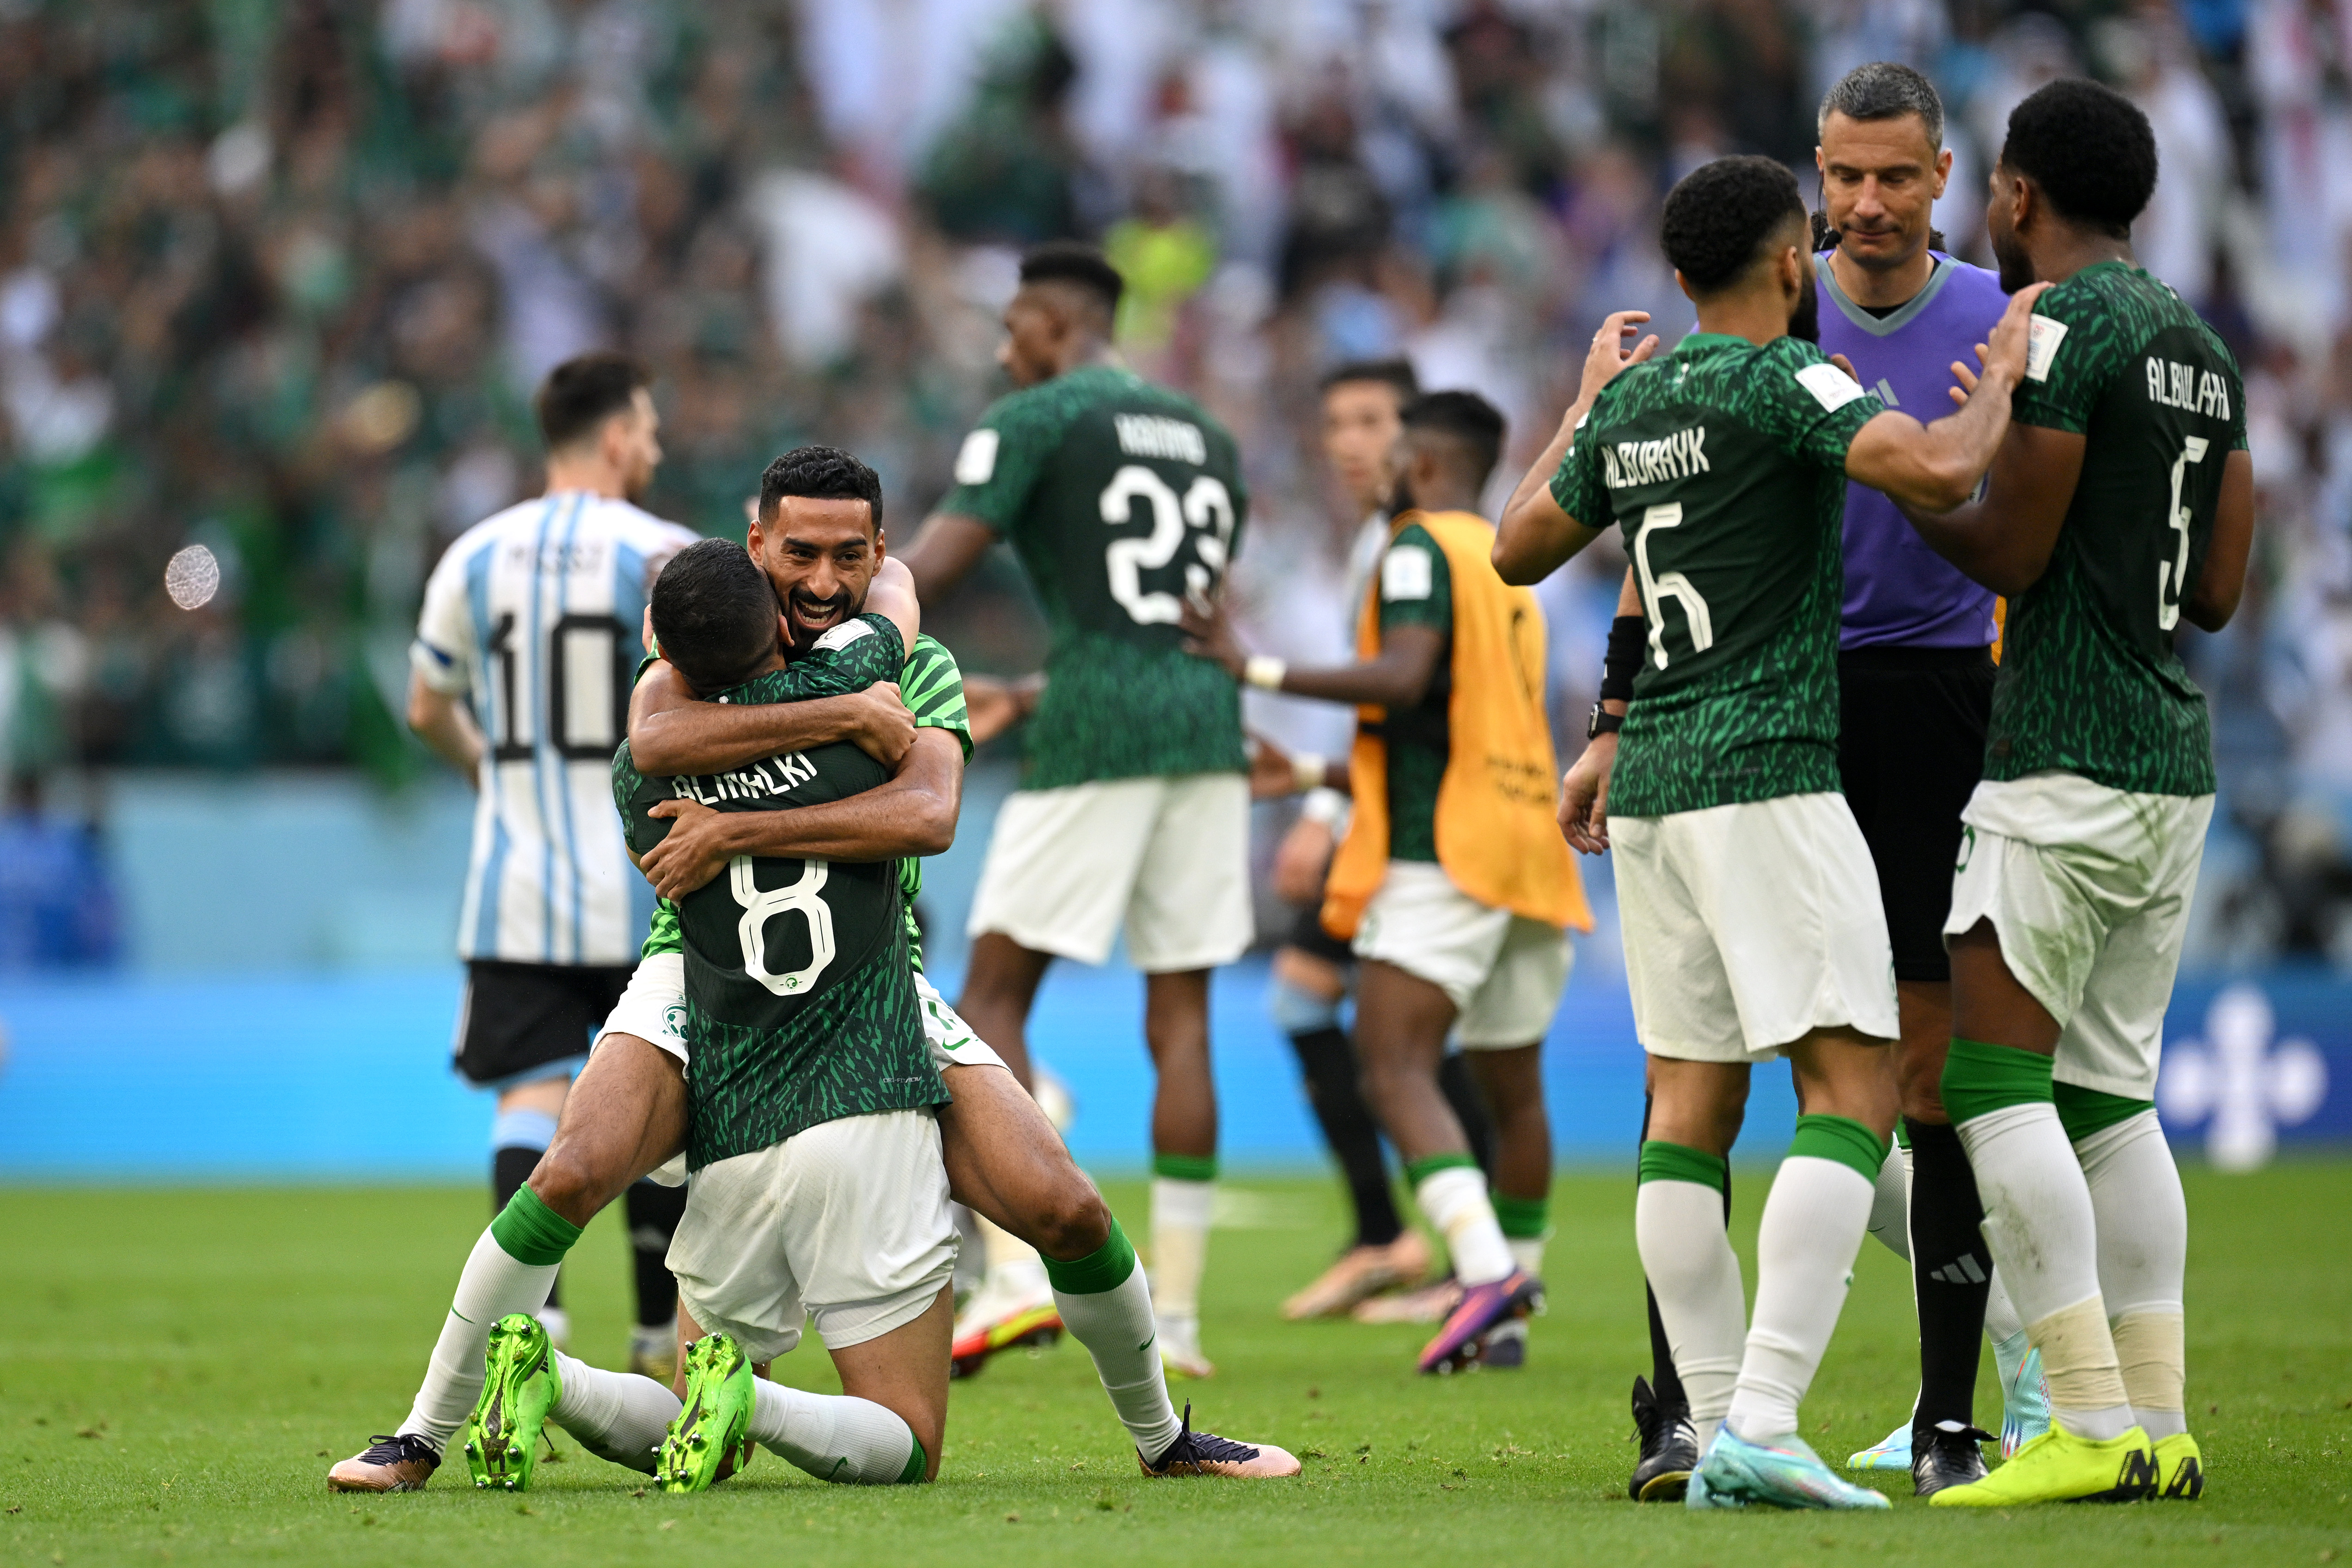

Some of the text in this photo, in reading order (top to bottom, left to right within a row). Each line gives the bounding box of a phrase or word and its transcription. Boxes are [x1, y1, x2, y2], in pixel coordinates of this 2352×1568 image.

[1601, 425, 1711, 489] ALBURAYK
[1099, 464, 1235, 626] 23
[2159, 435, 2210, 631] 5
[487, 612, 631, 761] 10
[672, 750, 818, 805] ALMALKI
[730, 855, 836, 996] 8
